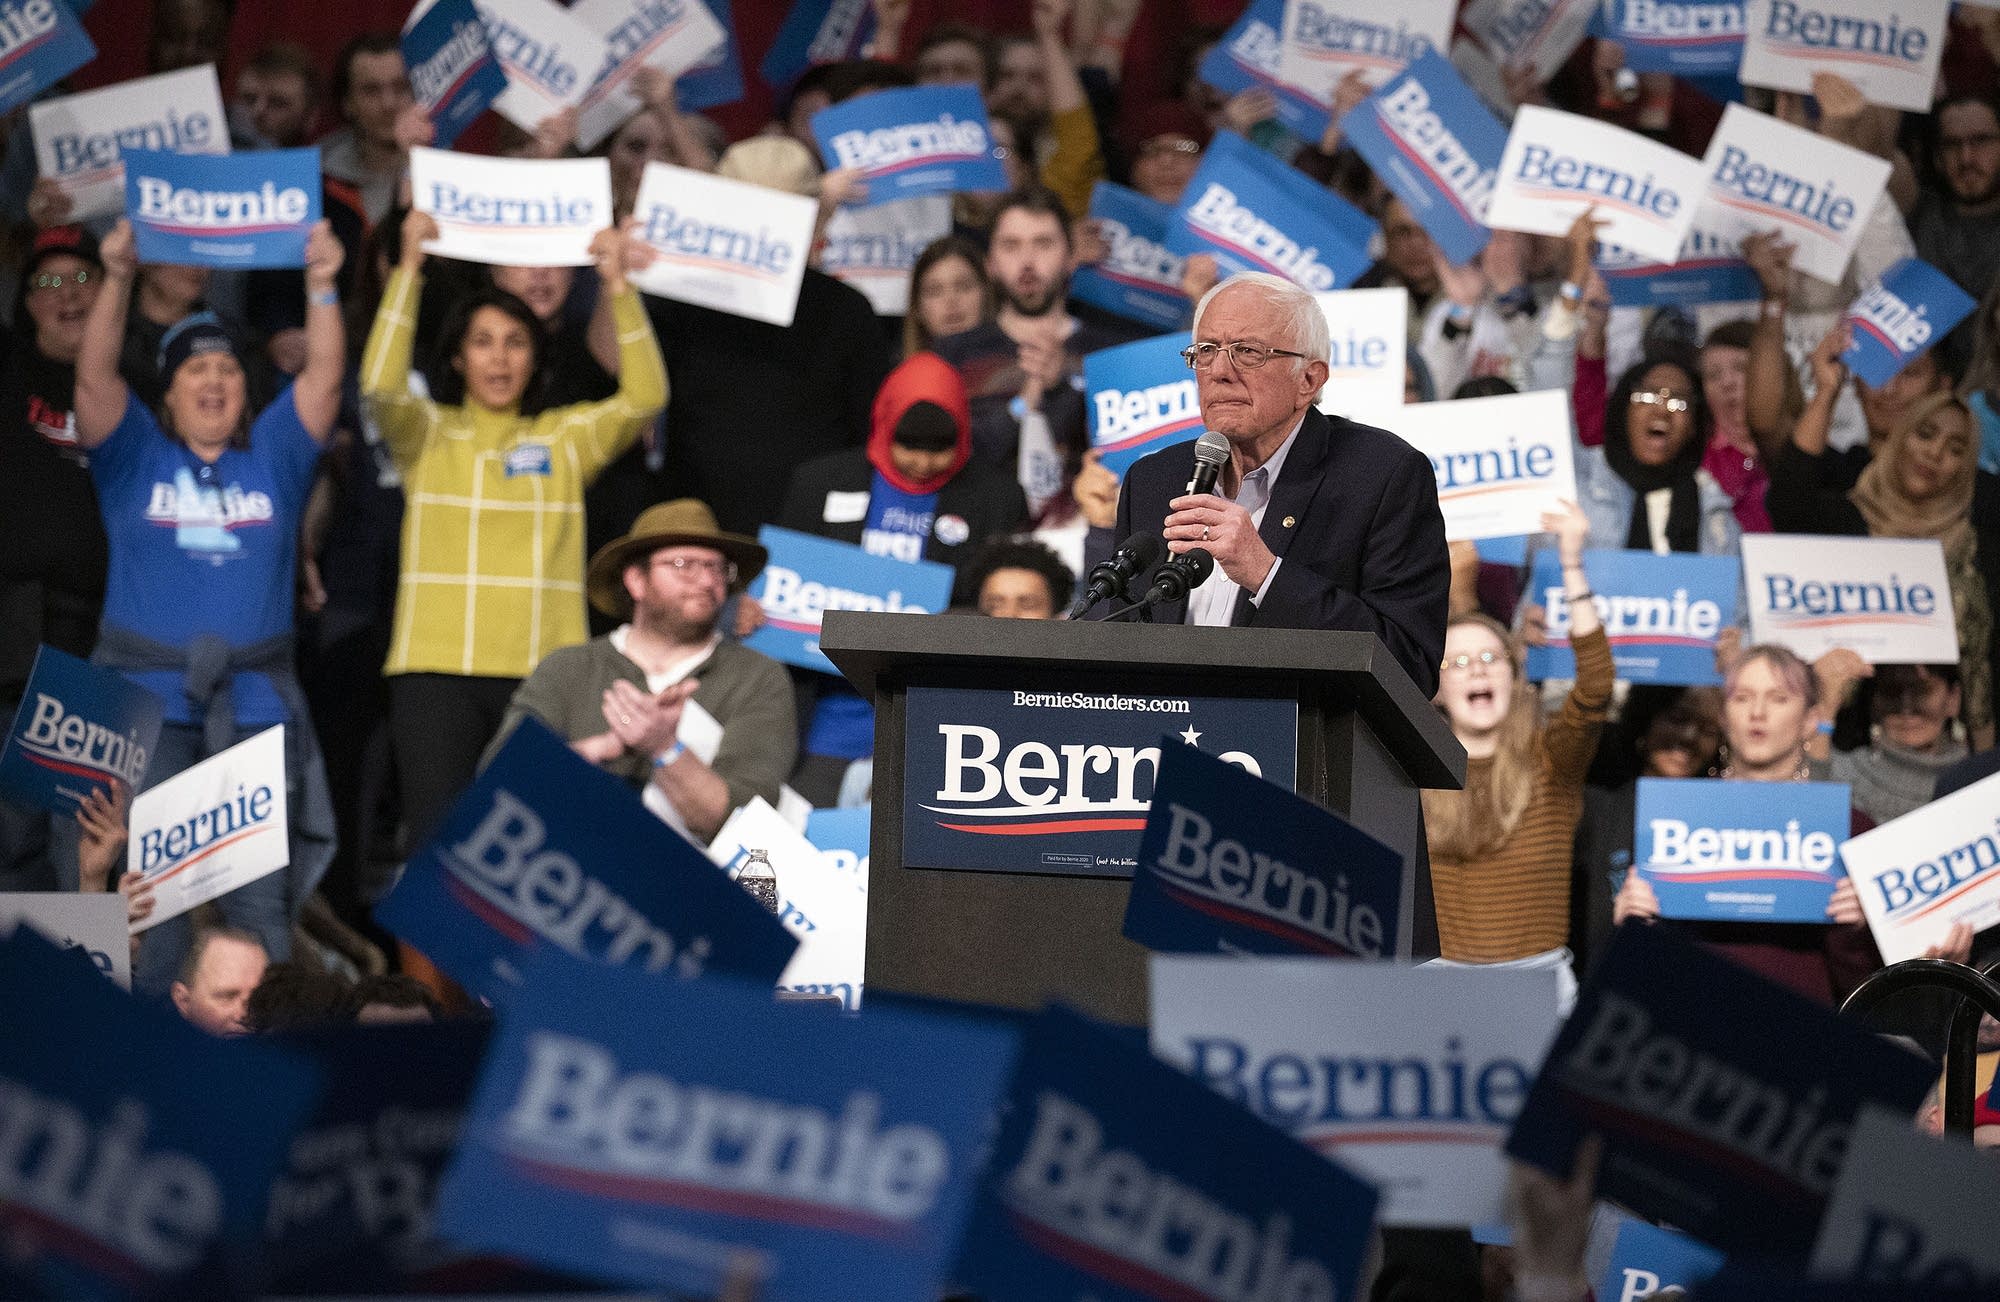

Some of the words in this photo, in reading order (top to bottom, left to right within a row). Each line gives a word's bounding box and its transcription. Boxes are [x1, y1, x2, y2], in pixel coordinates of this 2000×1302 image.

[1622, 0, 1743, 33] Bern
[1763, 0, 1930, 61] Bernie
[50, 107, 211, 178] Bernie
[831, 114, 988, 169] Bernie
[1378, 78, 1496, 221] Berni
[137, 176, 309, 224] Bernie
[429, 181, 594, 227] Bernie
[1516, 144, 1680, 219] Bernie
[1713, 145, 1855, 232] Bernie
[645, 203, 793, 275] Bernie
[1186, 182, 1336, 291] Bernie
[1094, 379, 1200, 438] Bern
[1430, 437, 1555, 487] rnie
[1766, 574, 1936, 616] Bernie
[25, 693, 147, 779] Bernie
[1013, 691, 1190, 713] BernieSanders.com
[936, 723, 1263, 809] Bern
[139, 784, 273, 872] Bernie
[1110, 857, 1119, 865] the
[1650, 819, 1836, 872] Bernie
[452, 788, 714, 980] Bern
[1156, 802, 1386, 960] Bernie
[1873, 816, 2000, 913] Berni
[505, 1032, 950, 1220] Bernie
[1567, 990, 1852, 1195] Bernie
